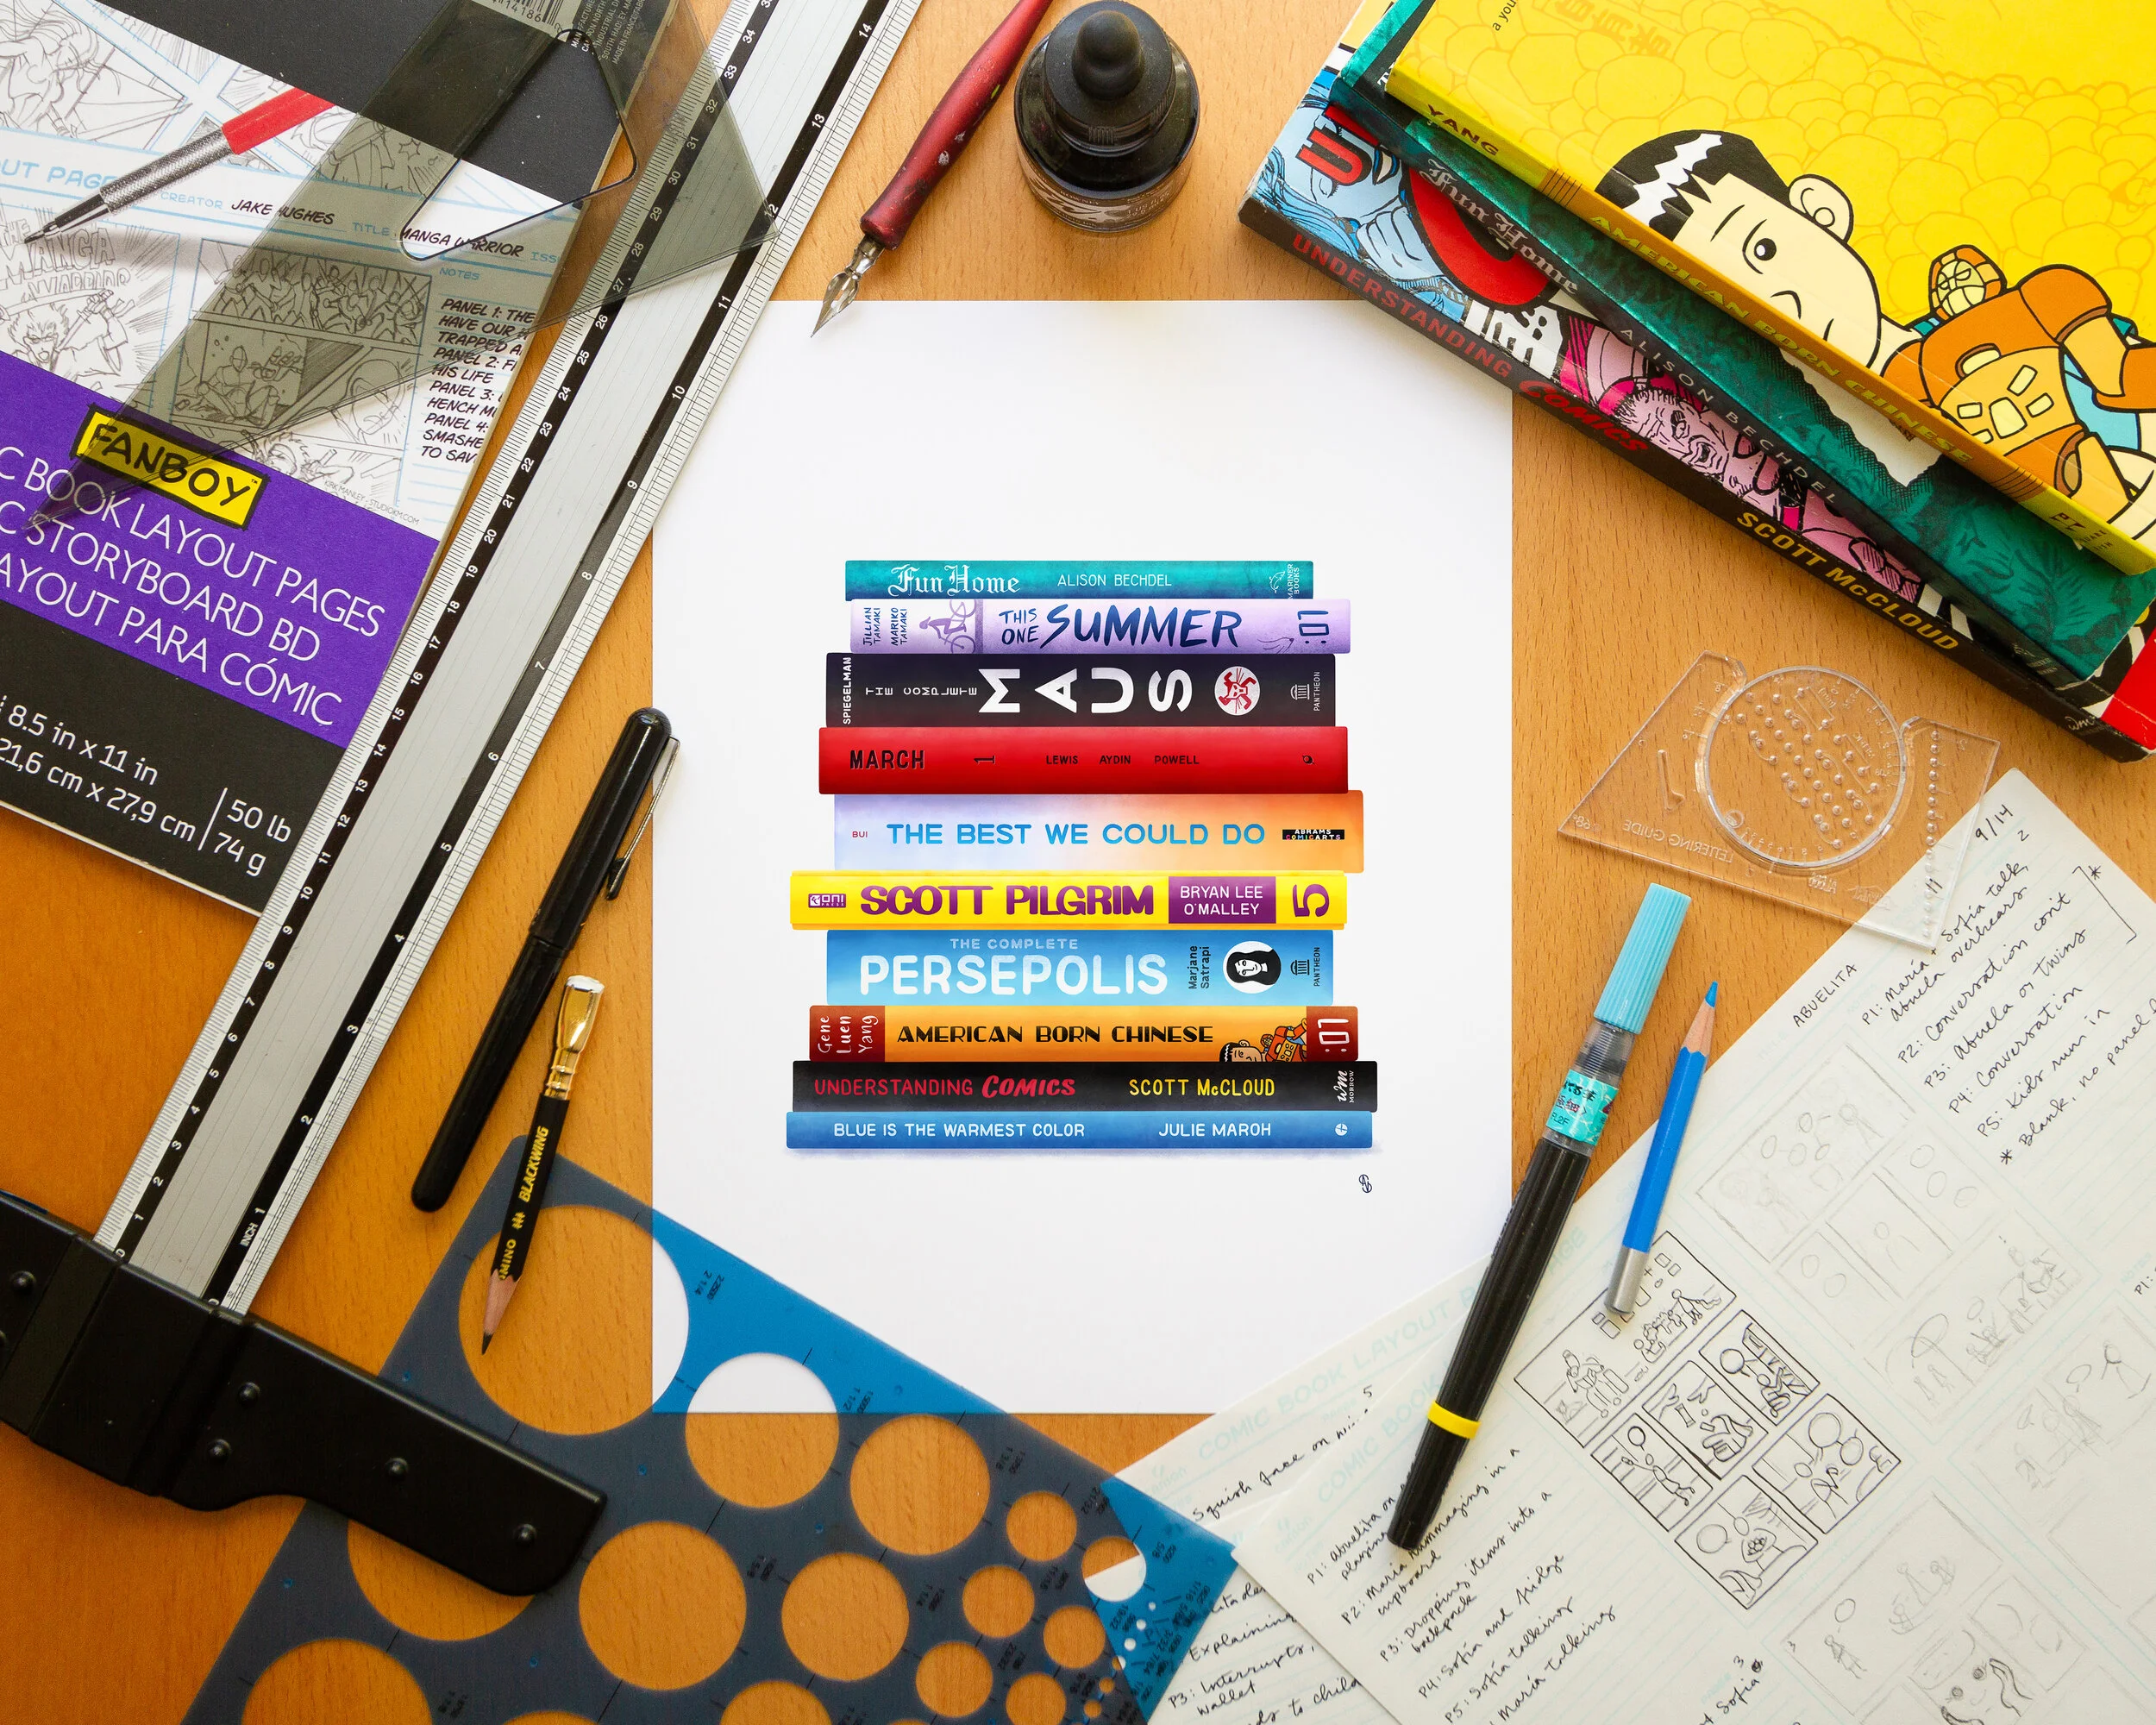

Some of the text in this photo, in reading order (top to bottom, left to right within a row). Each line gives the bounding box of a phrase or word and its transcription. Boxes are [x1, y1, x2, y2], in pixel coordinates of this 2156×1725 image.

[857, 22, 873, 40] 14
[611, 47, 622, 65] MADE
[724, 65, 738, 79] 33
[812, 113, 826, 129] 13
[1427, 104, 1500, 157] YANG
[668, 171, 681, 185] 30
[160, 191, 222, 210] CREATOR
[231, 199, 273, 215] JAKE
[353, 222, 390, 235] TITLE
[1420, 158, 1580, 296] Fun Home
[439, 267, 480, 280] NOTES
[441, 298, 487, 317] PANEL
[507, 309, 536, 323] THE
[718, 294, 732, 310] 11
[1292, 232, 1514, 380] UNDERSTANDING
[438, 315, 516, 337] HAVE OUR
[437, 331, 507, 353] TRAPPED
[1588, 215, 1977, 467] AMERICAN BORN CHINESE
[433, 347, 499, 369] PANEL 2:
[576, 350, 590, 366] 25
[432, 364, 494, 384] HIS LIFE
[429, 380, 494, 401] PANEL 3:
[427, 397, 479, 415] HENCH
[1620, 327, 1839, 506] ALISON BECHDEL
[425, 412, 489, 434] PANEL 4:
[421, 445, 442, 459] TO
[87, 423, 252, 506] FANBOY
[24, 458, 385, 638] BOOK LAYOUT PAGES
[465, 565, 479, 580] 19
[887, 564, 1172, 597] Fun Home ALISON BECHDEL
[1735, 510, 1960, 653] SCOTT McCLOUD
[25, 512, 321, 662] STORYBOARD BD
[862, 607, 873, 646] JILLIAN
[999, 608, 1037, 624] THIS
[1040, 604, 1242, 649] SUMMER
[1001, 625, 1039, 645] ONE
[118, 606, 209, 673] PARA
[218, 650, 343, 727] CÓMIC
[411, 671, 424, 686] 16
[843, 656, 851, 724] SPIEGELMAN
[904, 687, 977, 696] COMPLETE
[978, 668, 1193, 714] MAUS
[9, 705, 158, 785] 8.5 in x 11 in
[849, 750, 925, 770] MARCH
[1046, 755, 1200, 765] LEWIS AYDIN POWELL
[47, 759, 85, 794] cm
[85, 782, 104, 802] x
[106, 792, 158, 825] 27,9
[160, 813, 197, 843] cm
[226, 800, 292, 843] 50 lb
[1974, 804, 2015, 841] 9/14
[887, 823, 1265, 845] THE BEST WE COULD DO
[214, 831, 267, 877] 74 g
[441, 842, 452, 852] 5
[861, 885, 1154, 916] SCOTT PILGRIM
[1180, 886, 1263, 899] BRYAN LEE
[1293, 883, 1330, 918] 5
[1184, 903, 1259, 915] O'MALLEY
[950, 938, 1078, 950] THE COMPLETE
[860, 954, 1169, 996] PERSEPOLIS
[1188, 945, 1198, 989] Marjane
[1200, 945, 1210, 988] Satrapi
[1792, 963, 1858, 1027] ABUELITA
[347, 1024, 360, 1036] 3
[818, 1015, 830, 1053] Gene
[836, 1015, 852, 1054] Luen
[857, 1015, 879, 1053] Yang
[897, 1026, 1213, 1043] AMERICAN BORN CHINESE
[814, 1079, 973, 1096] UNDERSTANDING
[1129, 1079, 1275, 1096] SCOTT McCLOUD
[834, 1124, 1085, 1137] BLUE IS THE WARMEST COLOR
[1159, 1123, 1271, 1137] JULIE MAROH
[518, 1126, 548, 1203] BLACKWING
